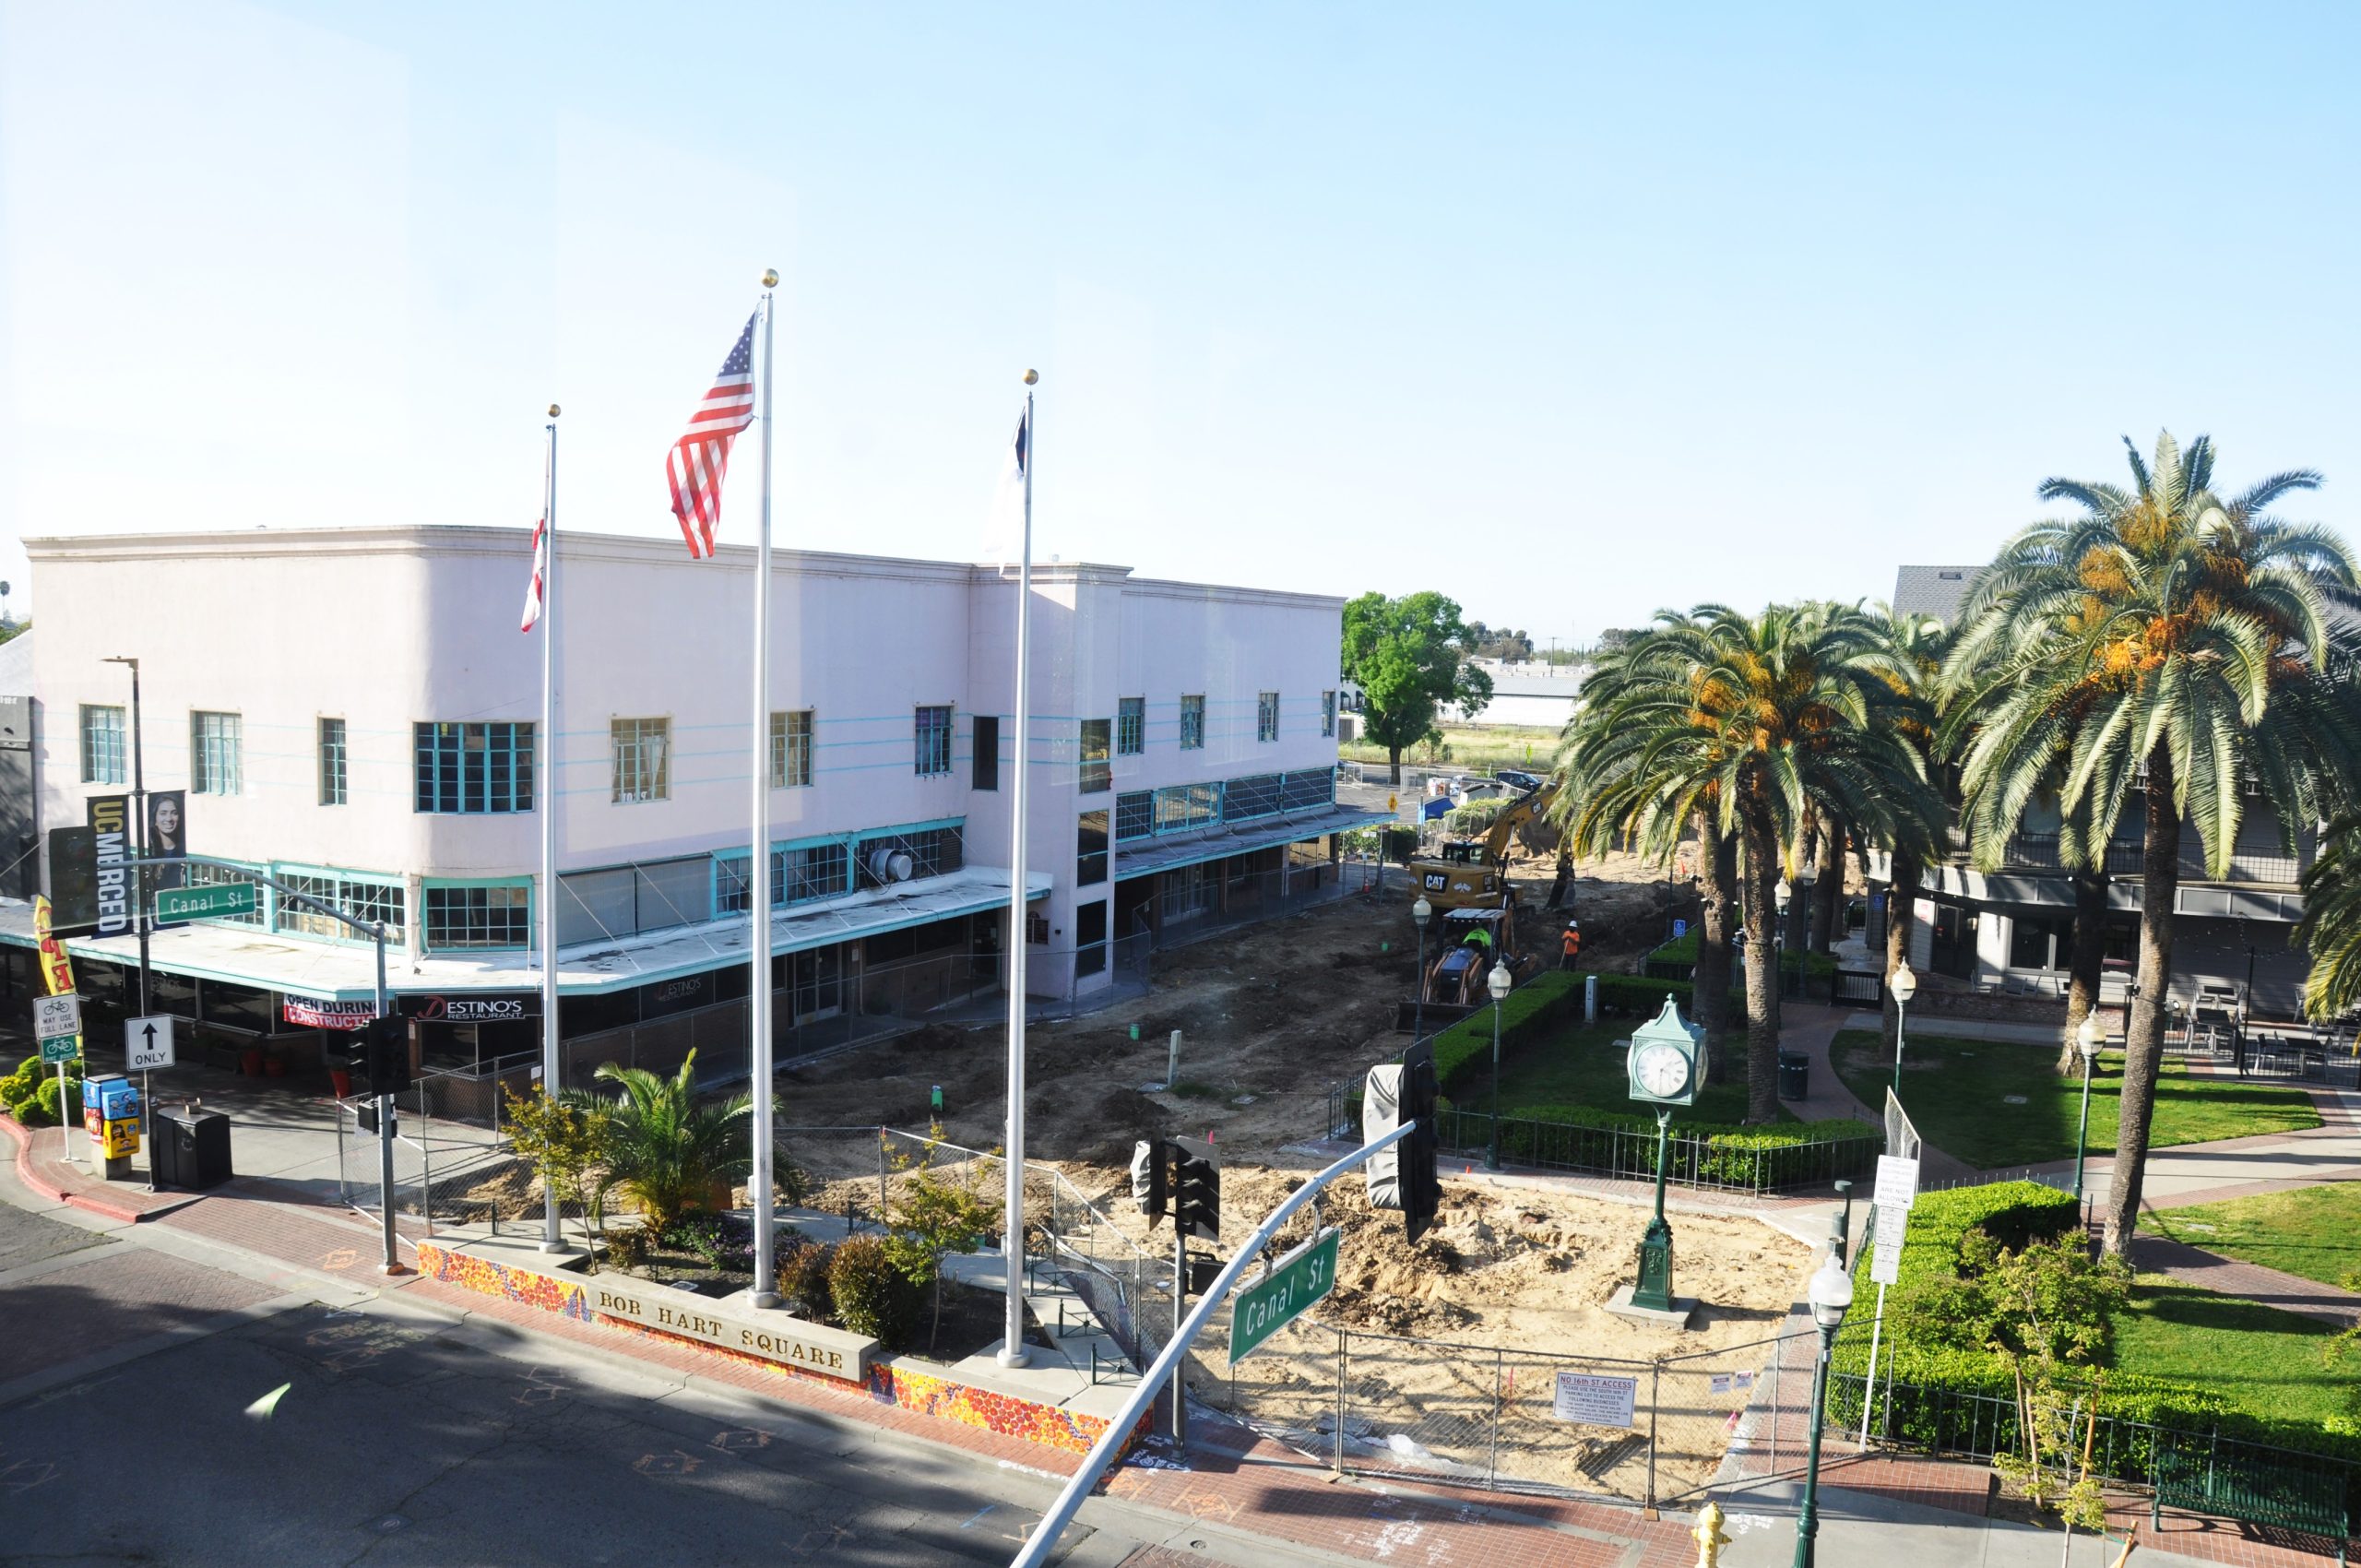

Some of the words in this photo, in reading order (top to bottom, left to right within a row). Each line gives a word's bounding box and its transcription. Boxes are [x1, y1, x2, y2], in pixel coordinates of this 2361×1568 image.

[1426, 874, 1445, 890] CAT
[170, 895, 214, 914] Canal
[228, 891, 243, 908] St
[287, 993, 319, 1012] OPEN
[416, 994, 523, 1019] DESTINO'S
[60, 1014, 72, 1022] USE
[288, 1007, 375, 1028] CONSTRUCTI
[447, 1012, 522, 1020] RESTAURANT
[59, 1021, 76, 1030] LANE
[135, 1051, 166, 1064] ONLY
[1246, 1275, 1295, 1336] Canal
[1308, 1253, 1325, 1291] St
[599, 1291, 641, 1315] BOB
[658, 1307, 722, 1337] HART
[741, 1329, 843, 1370] SQUARE
[1573, 1377, 1589, 1385] 16th
[1601, 1381, 1632, 1389] ACCESS
